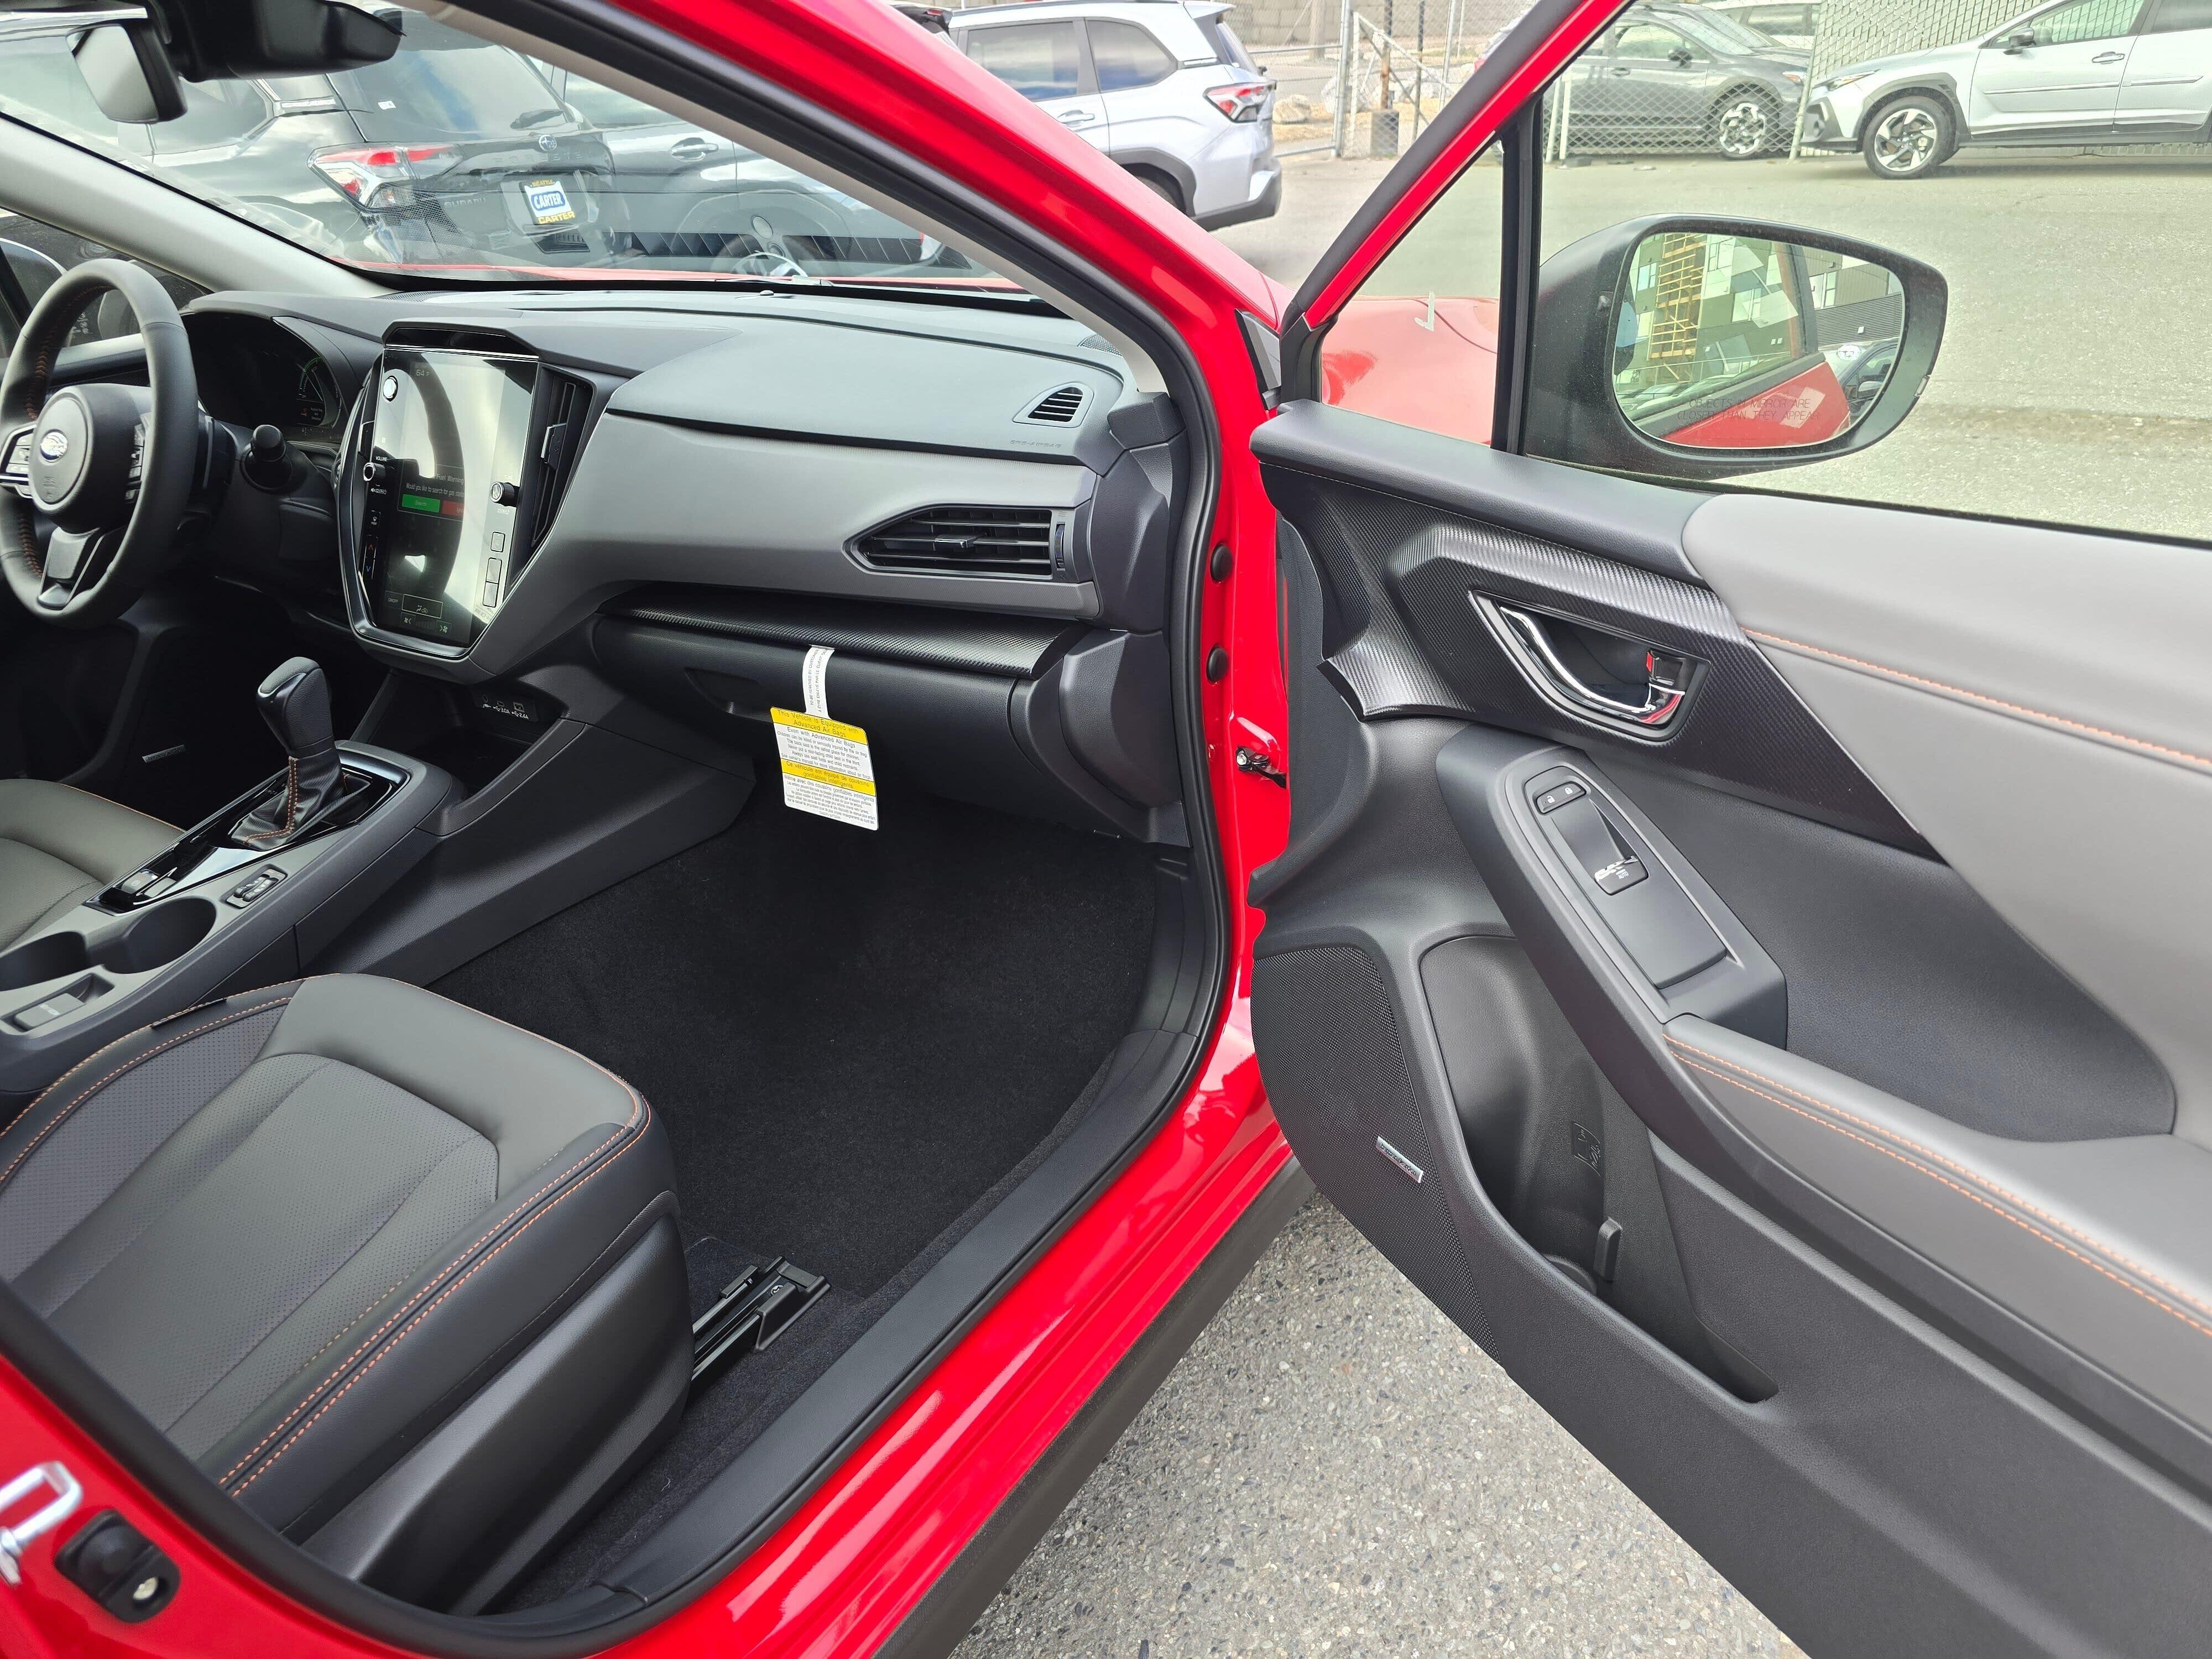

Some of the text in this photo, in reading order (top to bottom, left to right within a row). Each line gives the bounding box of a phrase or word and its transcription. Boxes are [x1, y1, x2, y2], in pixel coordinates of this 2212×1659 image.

[444, 197, 487, 208] SUBARU
[534, 194, 563, 209] CARTER
[538, 211, 576, 224] CARTER
[1689, 398, 1731, 408] OBJECTS
[1750, 398, 1786, 408] MIRROR
[1792, 398, 1811, 408] ARE
[1677, 410, 1715, 420] CLOSER
[1721, 410, 1746, 420] THAN
[1754, 410, 1779, 420] THEY
[447, 475, 465, 485] Warning
[792, 713, 811, 722] Vehicle
[821, 719, 845, 731] Equipped
[794, 719, 820, 730] Advanced
[833, 729, 846, 738] Bags
[811, 733, 833, 742] Advanced
[795, 763, 812, 771] véhicule
[823, 770, 839, 779] équipé
[849, 778, 869, 786] coussins
[803, 771, 853, 789] gonflables intelligents
[815, 782, 831, 791] coussins
[833, 787, 852, 797] gonflables
[1618, 870, 1629, 880] AUTO
